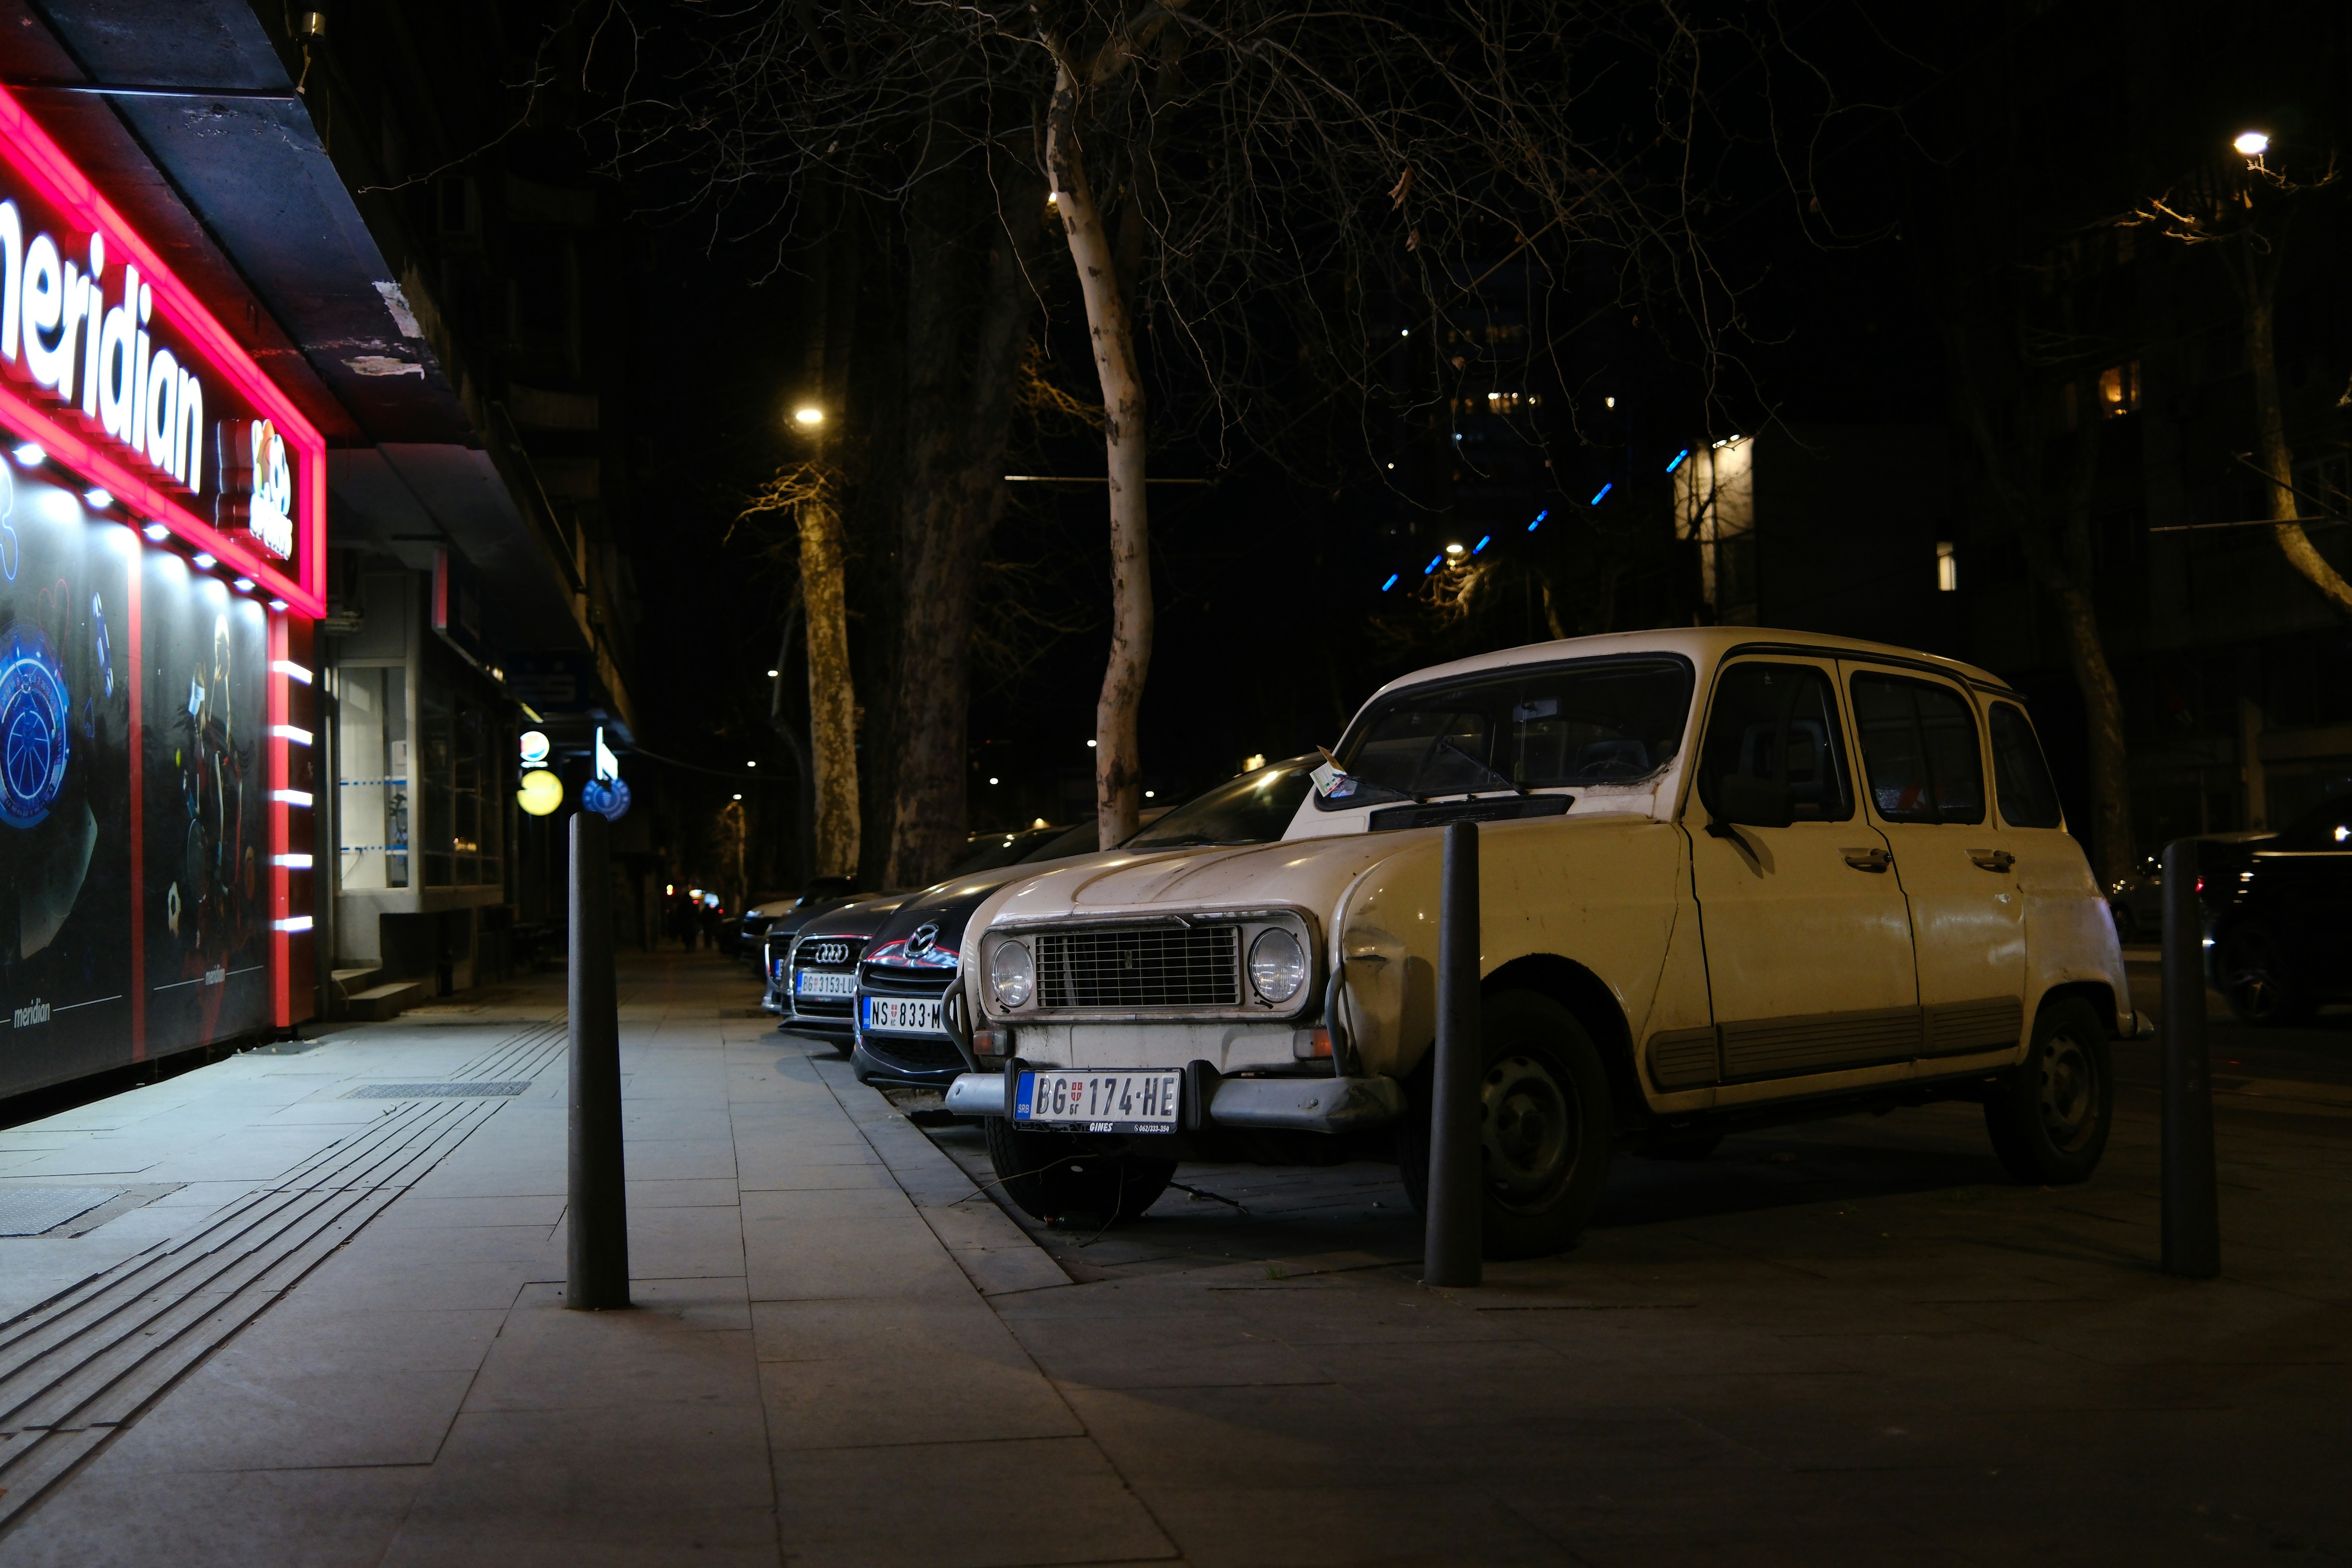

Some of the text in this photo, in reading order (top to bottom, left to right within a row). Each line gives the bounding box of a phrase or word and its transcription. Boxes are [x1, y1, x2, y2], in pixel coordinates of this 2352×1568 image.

[803, 976, 813, 992] BG
[14, 997, 50, 1029] meridian
[873, 1001, 888, 1025] NS
[1036, 1078, 1067, 1115] BG
[1018, 1103, 1029, 1114] SRB
[1089, 1122, 1113, 1132] GINES
